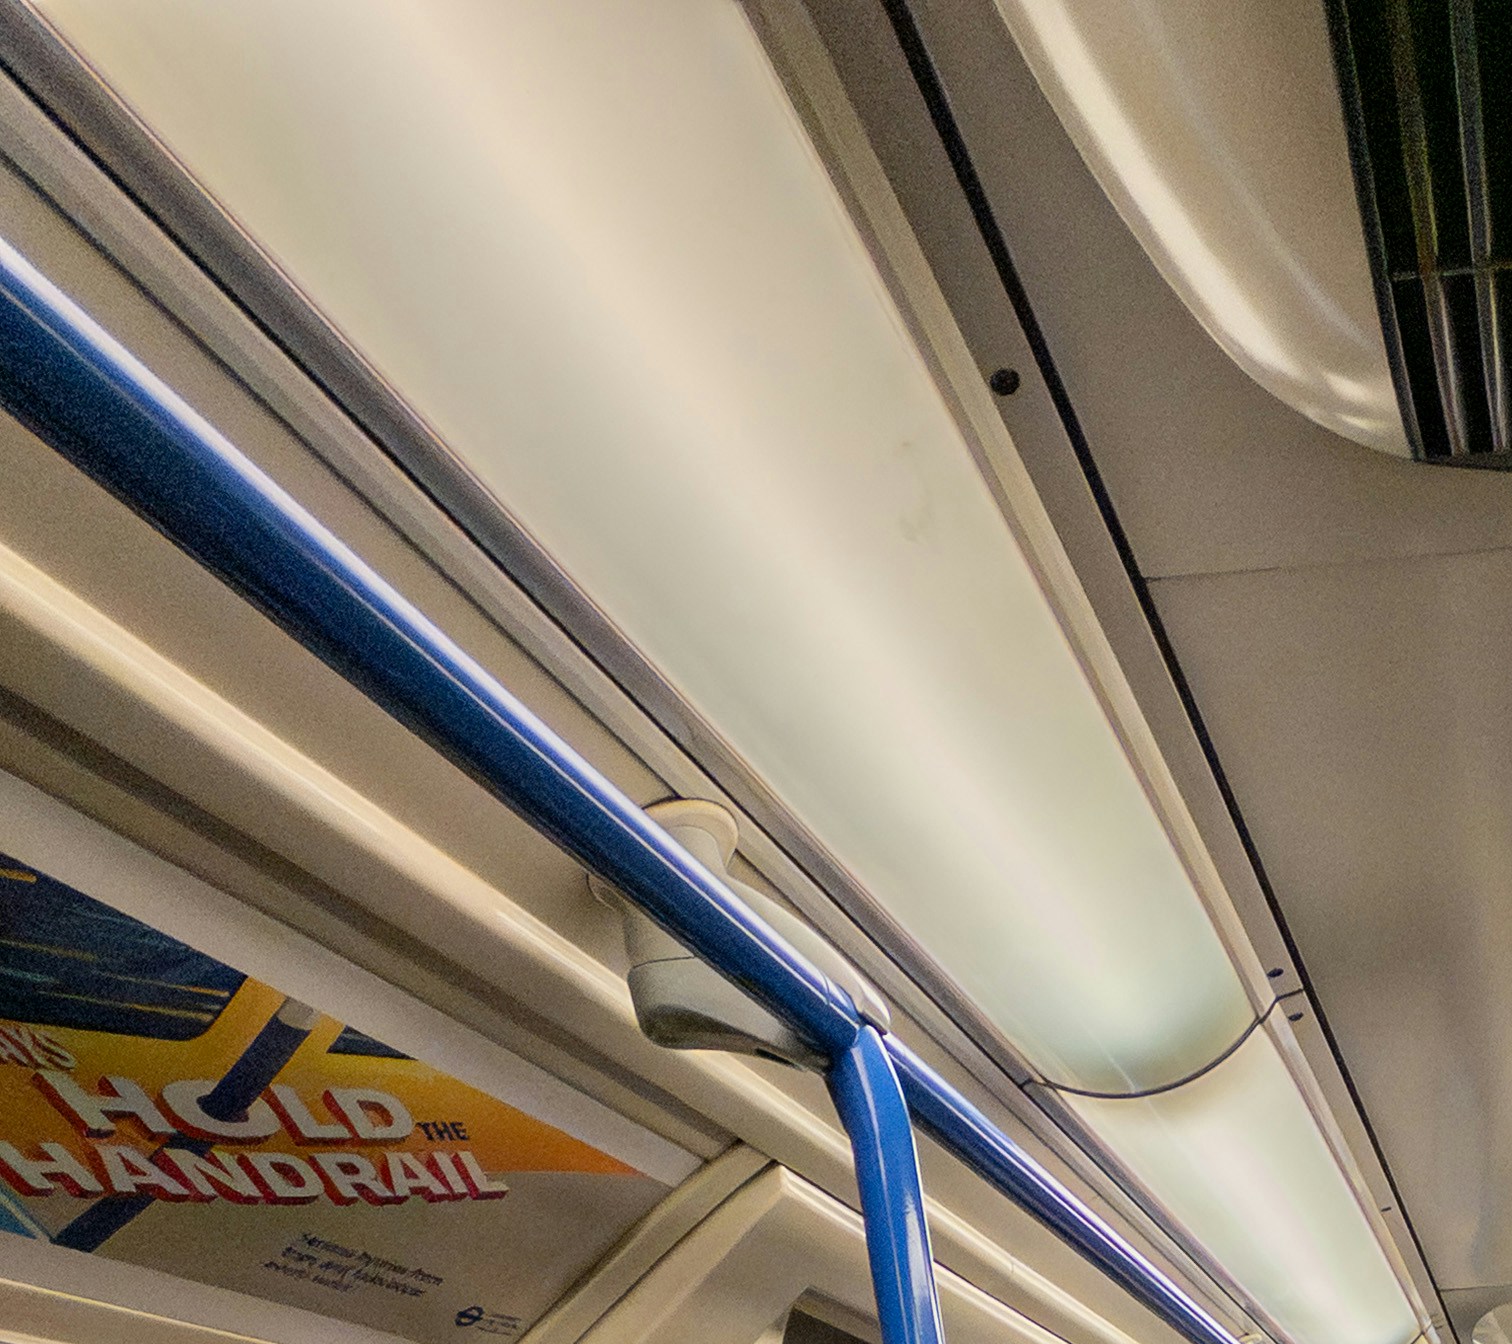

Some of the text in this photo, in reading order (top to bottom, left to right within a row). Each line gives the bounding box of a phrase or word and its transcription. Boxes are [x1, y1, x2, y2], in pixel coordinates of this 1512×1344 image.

[32, 1068, 469, 1146] HOLD THE
[0, 1139, 510, 1206] HANDRAIL
